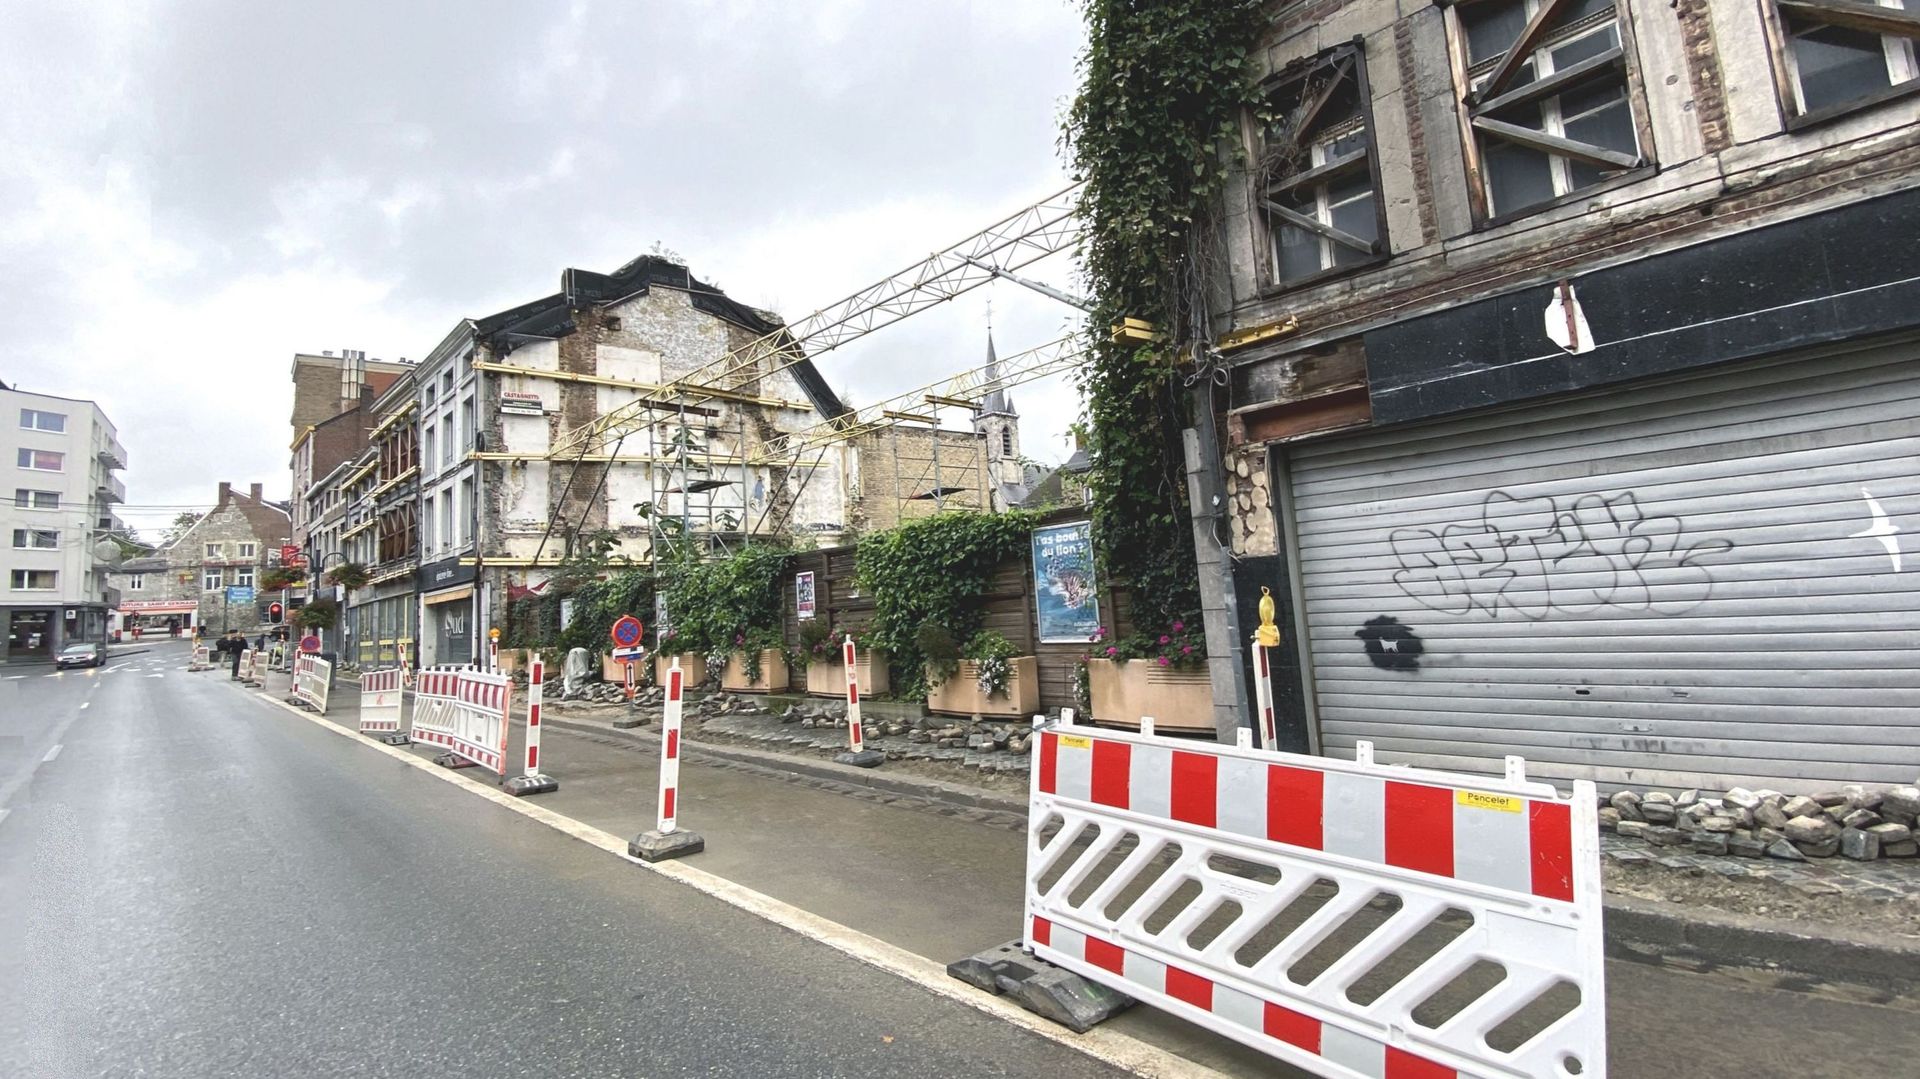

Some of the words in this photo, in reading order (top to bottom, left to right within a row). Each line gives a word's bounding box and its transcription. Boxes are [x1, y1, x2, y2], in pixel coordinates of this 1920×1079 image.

[1042, 547, 1053, 558] du
[1056, 543, 1076, 557] lion
[1467, 792, 1509, 805] Poncelet
